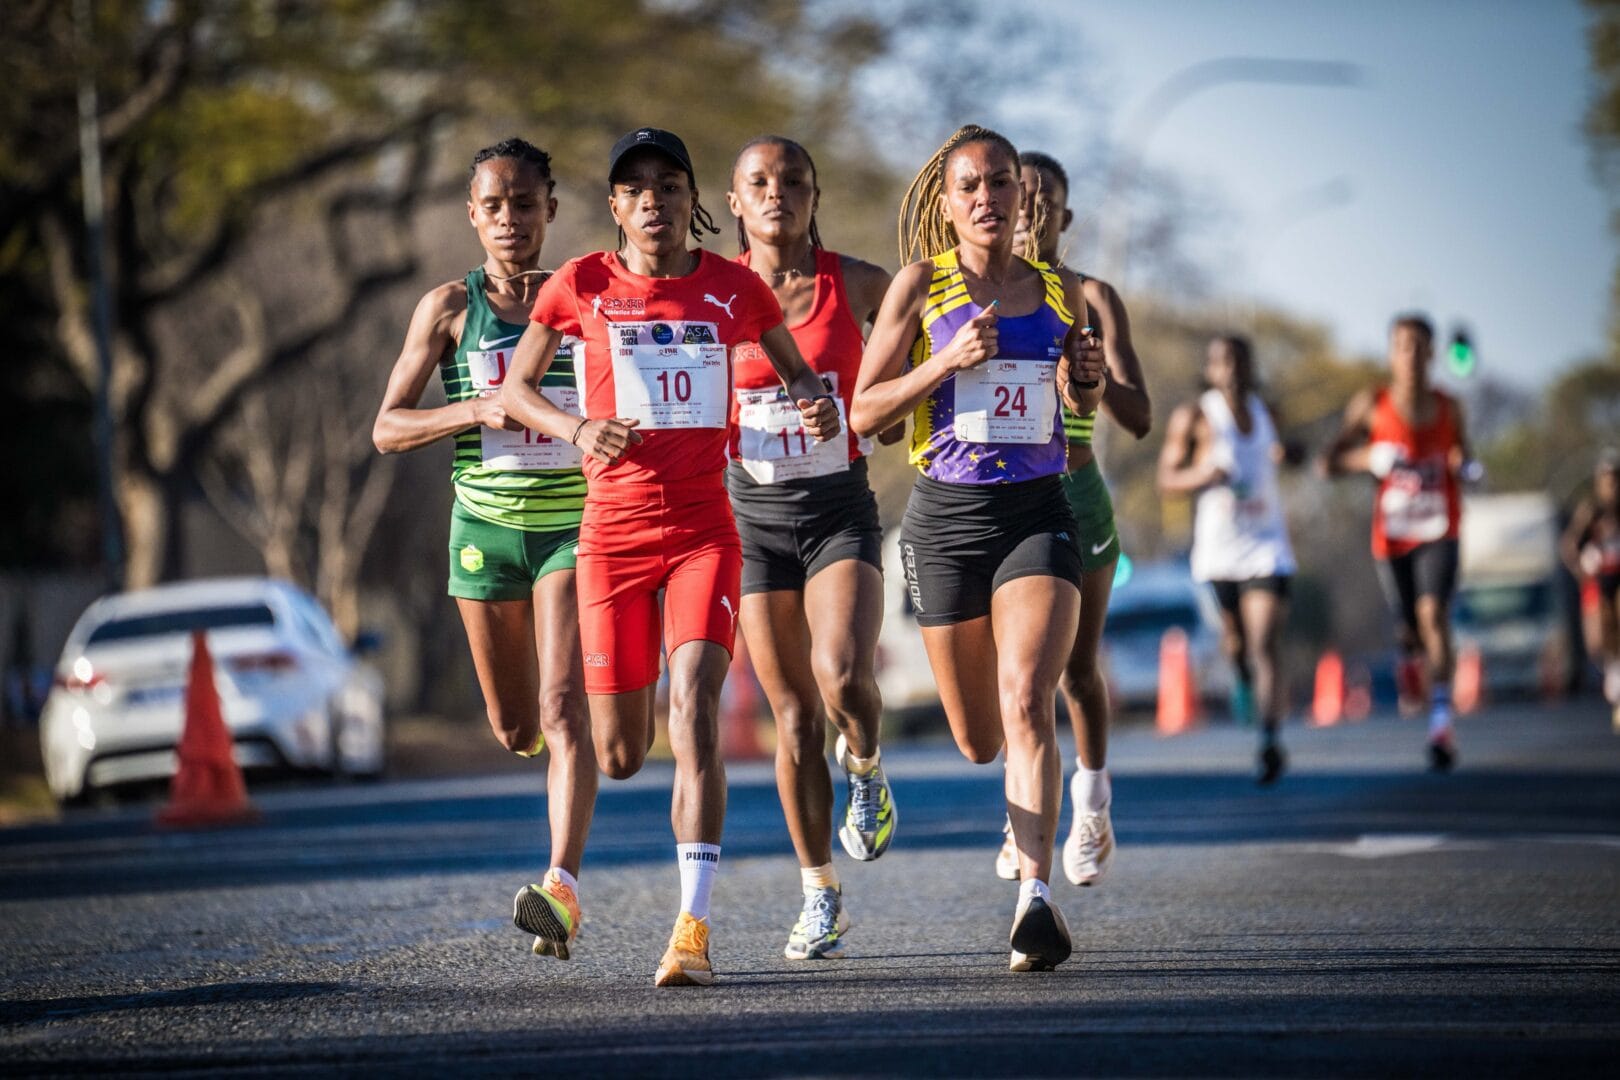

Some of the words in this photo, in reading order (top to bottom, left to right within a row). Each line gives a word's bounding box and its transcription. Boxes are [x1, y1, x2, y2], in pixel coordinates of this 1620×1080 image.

[621, 337, 639, 346] 2024
[686, 327, 711, 337] ASA
[656, 370, 691, 402] 10
[994, 385, 1028, 418] 24
[777, 426, 807, 456] 11
[686, 851, 719, 864] PUMA
